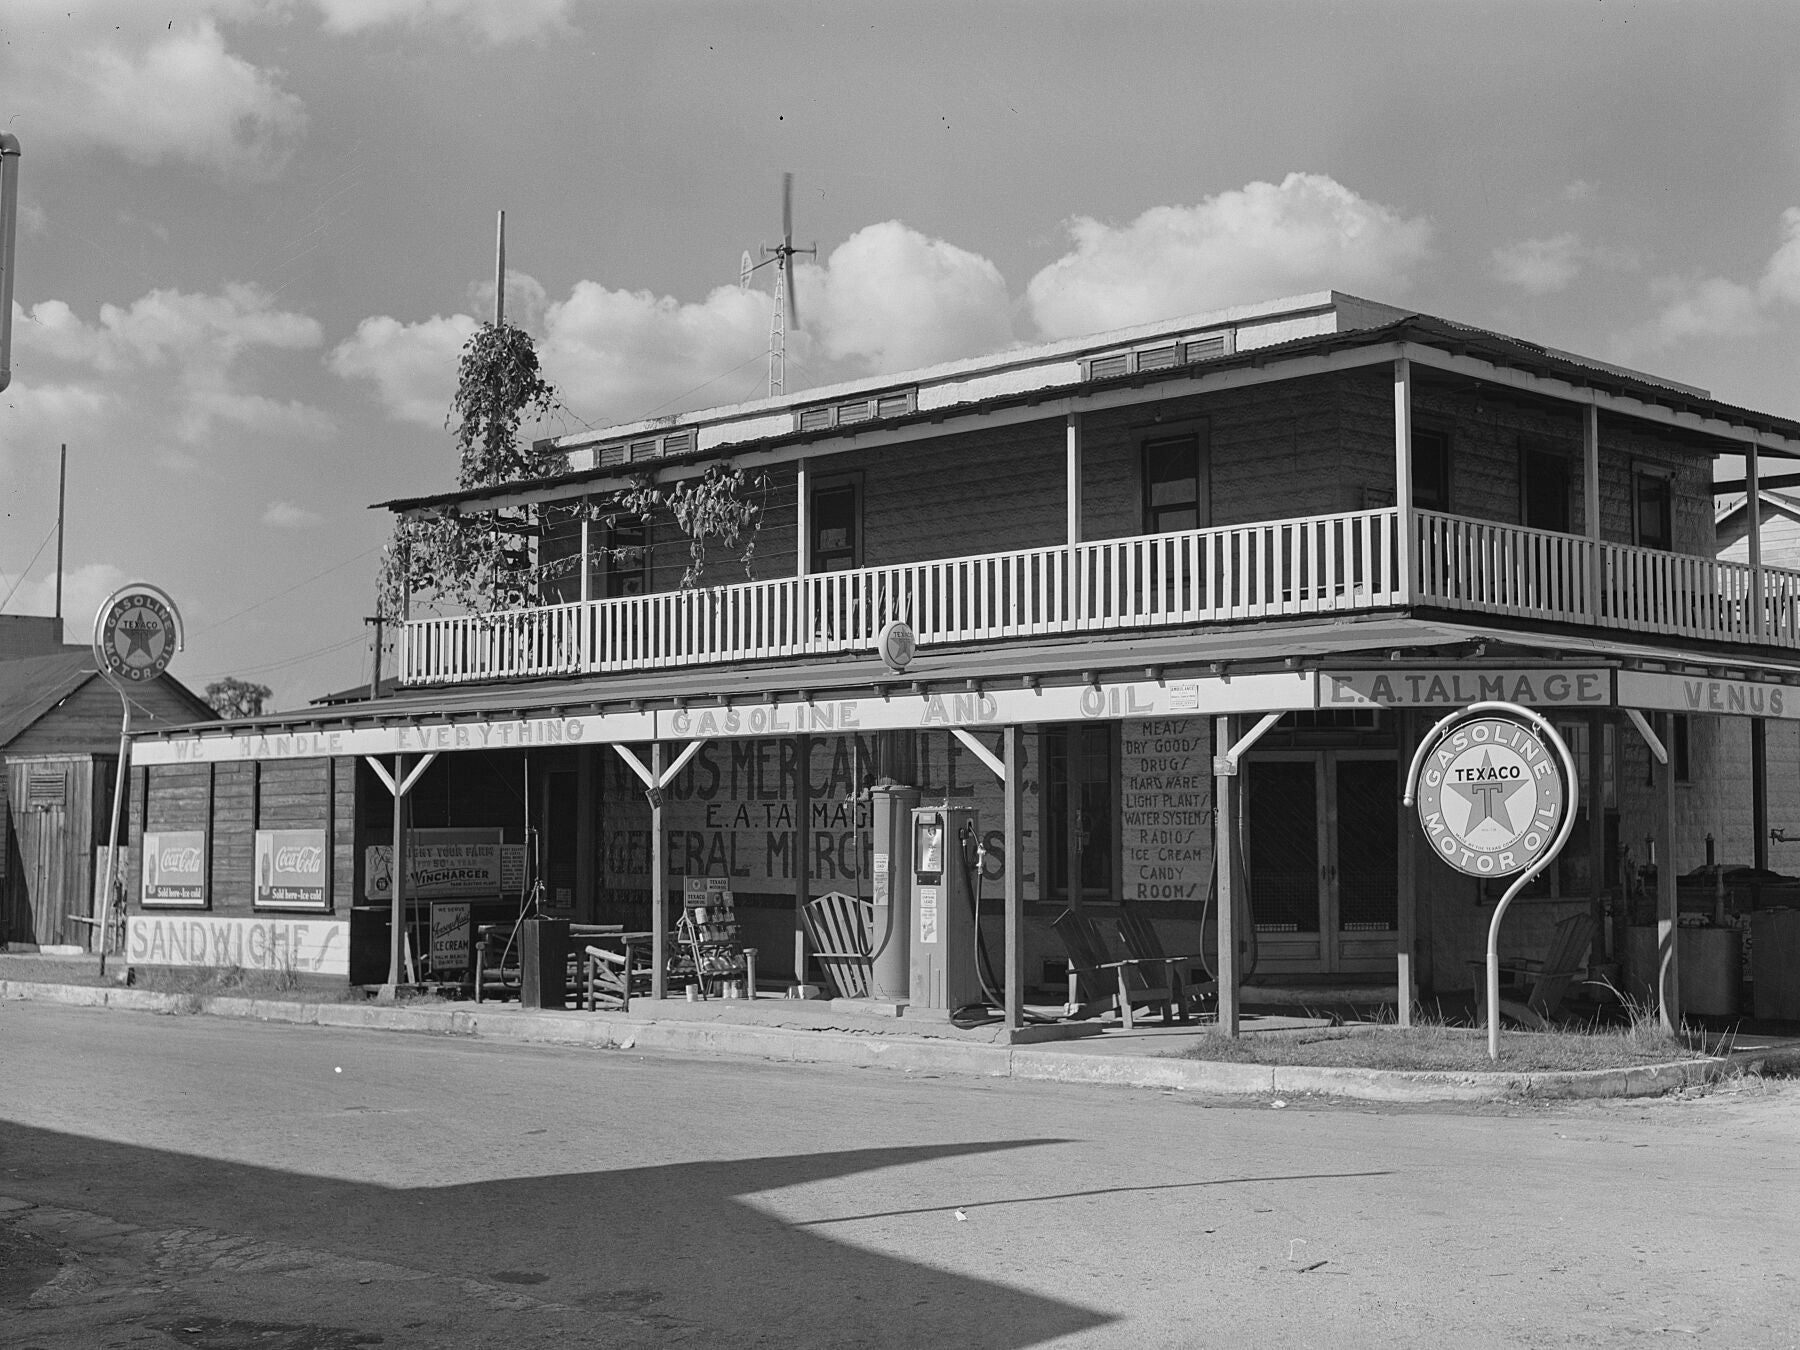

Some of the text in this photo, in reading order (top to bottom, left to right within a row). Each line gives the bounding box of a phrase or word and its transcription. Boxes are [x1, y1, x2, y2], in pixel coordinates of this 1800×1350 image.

[107, 596, 172, 629] GASOLINE
[124, 620, 157, 629] TEXACO
[105, 642, 151, 679] MOTOR
[156, 644, 173, 669] OIL
[1683, 680, 1784, 715] VENUS
[671, 702, 860, 736] GASOLINE
[920, 694, 998, 726] AND
[1079, 684, 1154, 719] OIL
[1142, 719, 1188, 736] MEATS
[175, 718, 585, 760] WE HANDLE EVERYTHING
[1126, 737, 1200, 754] DRY GOODS
[1141, 757, 1189, 772] DRUGS
[1425, 725, 1551, 788] GASOLINE
[1455, 766, 1520, 782] TEXACO
[1126, 794, 1208, 808] LIGHT PLANTS
[1472, 783, 1503, 818] T
[1125, 810, 1210, 826] WATER SYSTEMS
[1523, 803, 1555, 851] OIL
[1140, 829, 1194, 844] RADIOS
[1425, 812, 1516, 872] MOTOR
[1131, 847, 1201, 861] ICE CREAM
[410, 869, 489, 884] WINCHARGER
[1139, 865, 1185, 880] CANDY
[157, 887, 169, 897] Sold
[190, 888, 202, 898] cold
[272, 888, 285, 899] Sold
[309, 889, 322, 900] cold
[1137, 883, 1197, 898] ROOMS
[131, 919, 340, 971] SANDWICHES
[434, 940, 469, 951] ICE CREAM
